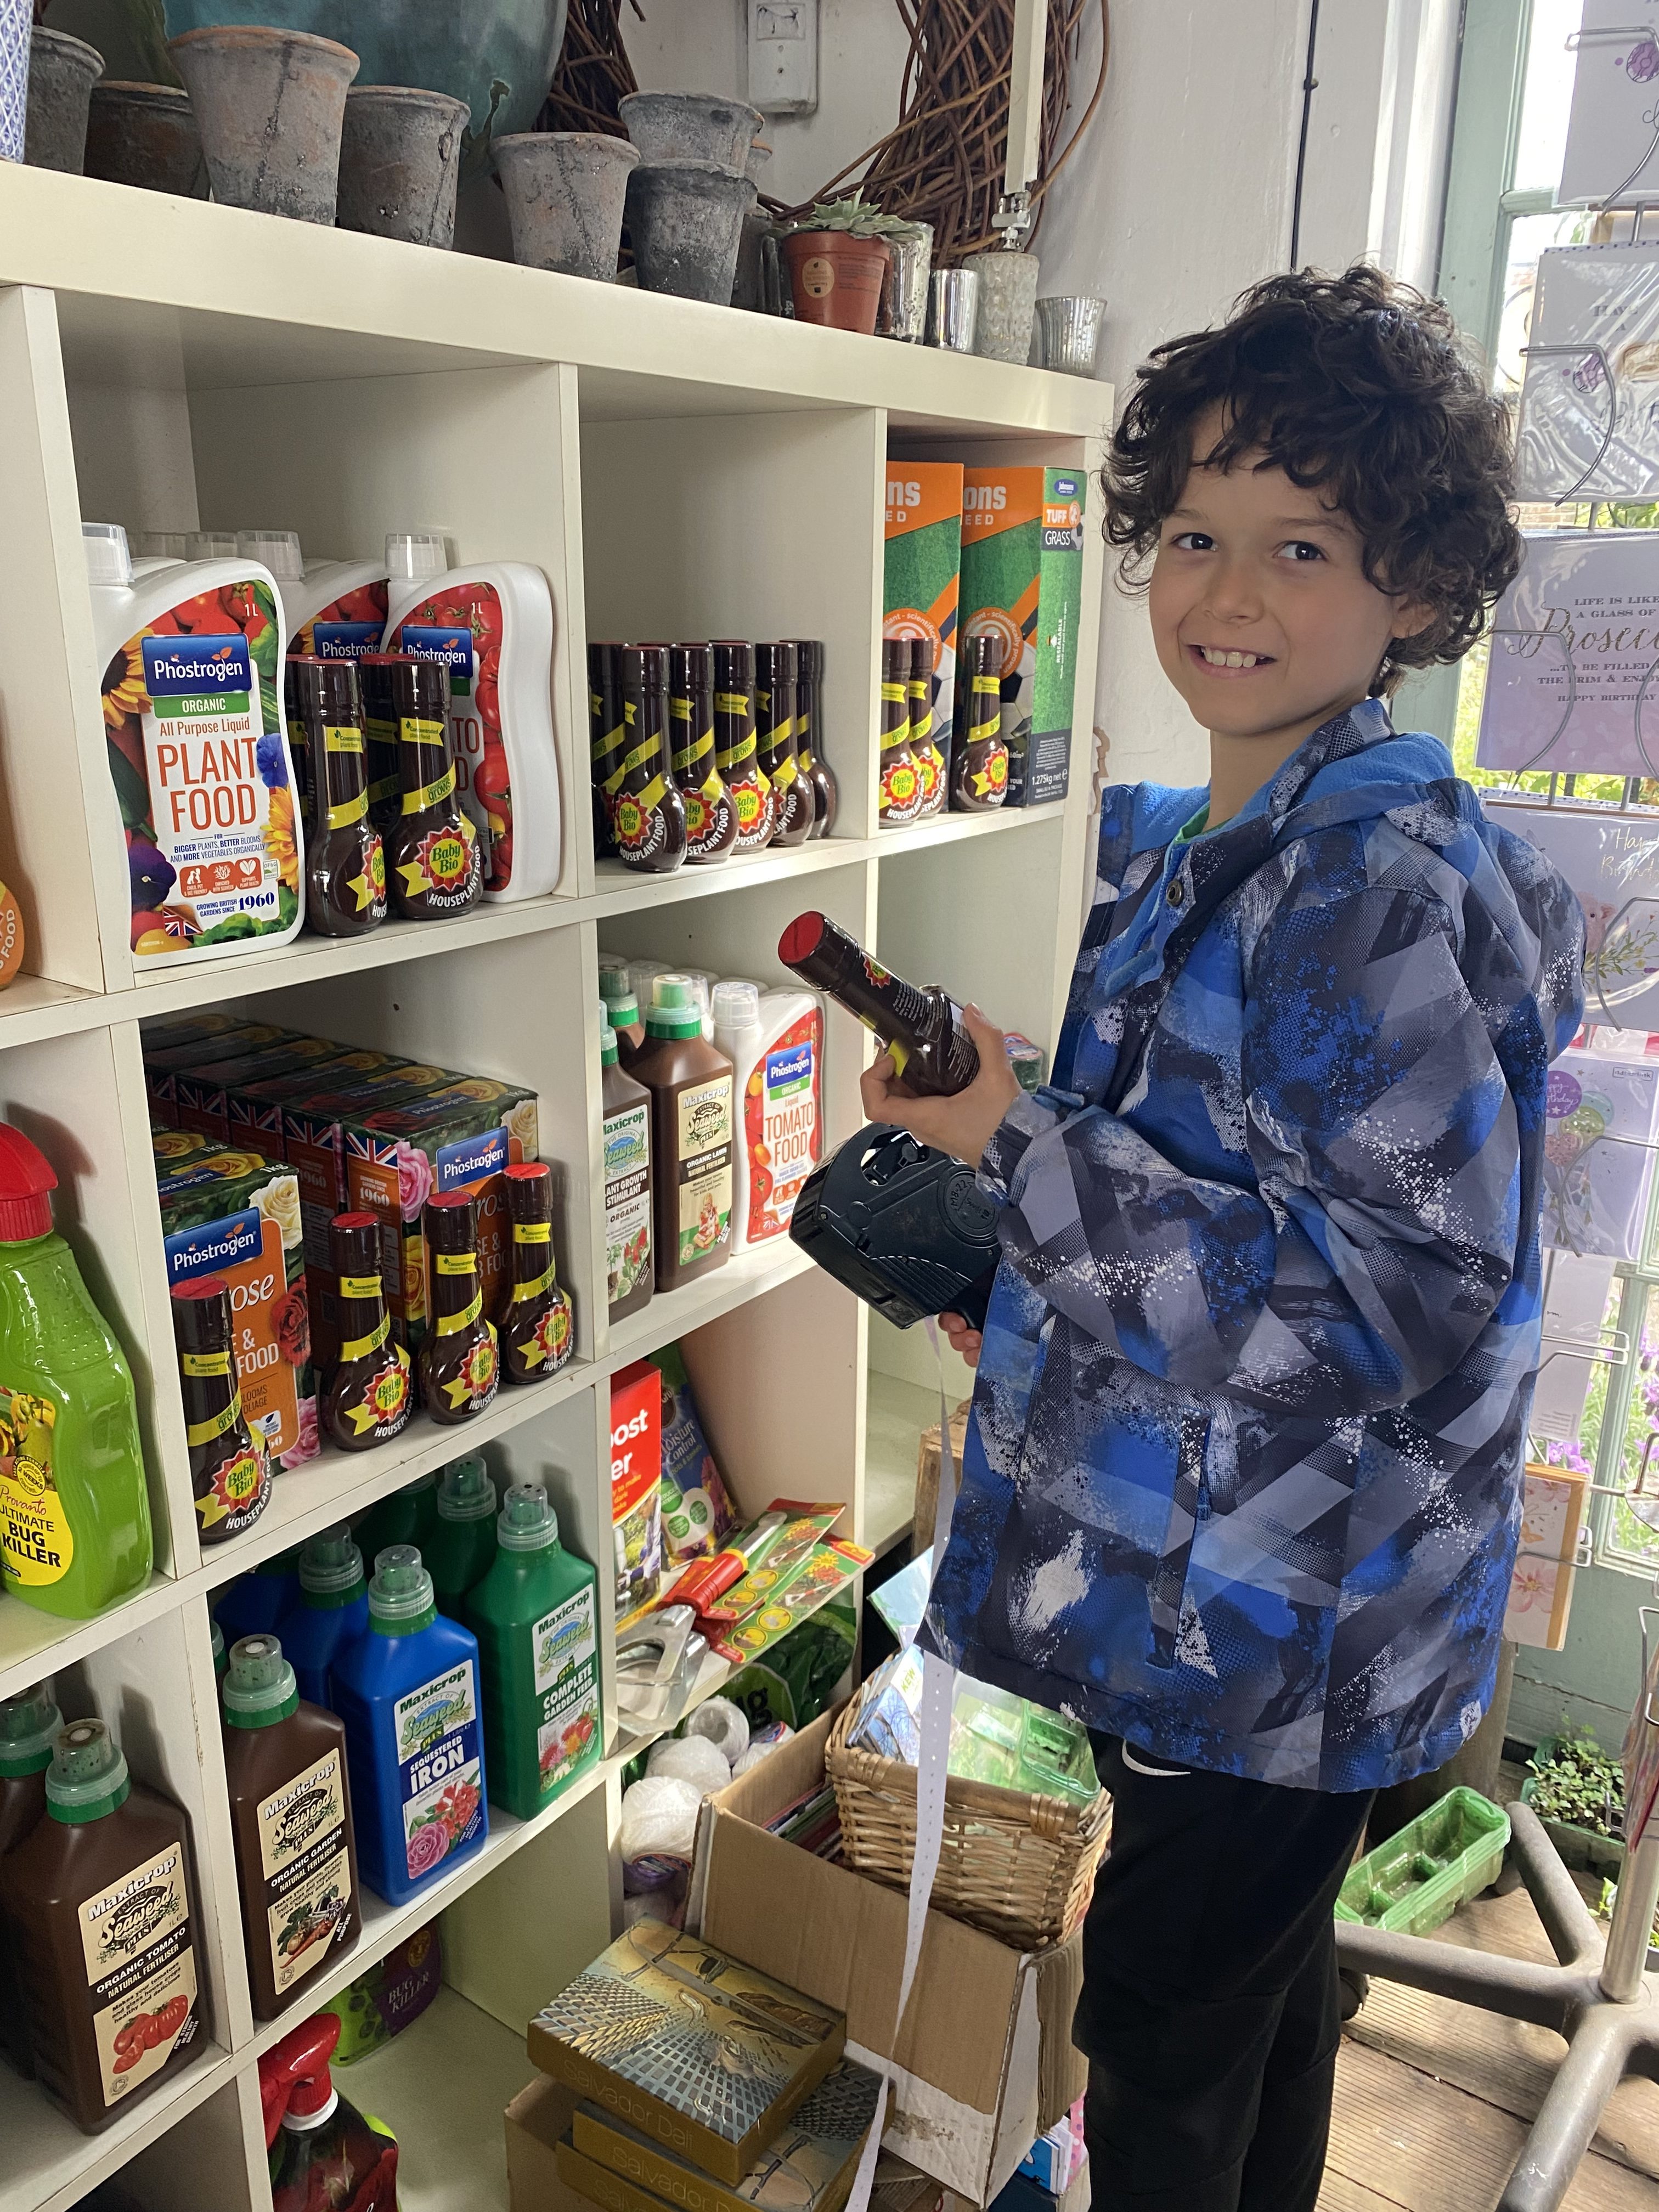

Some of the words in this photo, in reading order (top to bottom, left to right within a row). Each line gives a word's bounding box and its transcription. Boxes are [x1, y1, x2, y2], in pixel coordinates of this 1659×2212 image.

[1046, 509, 1067, 523] TUFF
[1045, 531, 1070, 546] GRASS
[1628, 596, 1659, 604] LIKE
[408, 644, 466, 667] Phostrogen
[154, 658, 242, 681] Phostrogen
[182, 698, 226, 713] ORGANIC
[160, 722, 173, 736] All
[177, 721, 218, 737] Purpose
[222, 716, 250, 734] Liquid
[157, 737, 256, 787] PLANT
[893, 772, 912, 786] Baby
[897, 783, 911, 795] Bio
[1032, 774, 1052, 785] 1.275kg
[170, 783, 256, 833] FOOD
[620, 808, 638, 822] Baby
[739, 805, 754, 817] Bio
[788, 793, 797, 819] FOOD
[887, 796, 922, 820] HOUSEPLANT
[624, 820, 636, 831] Bio
[720, 807, 729, 834] FOOD
[174, 843, 196, 853] BIGGER
[198, 840, 219, 850] PLANTS,
[220, 839, 239, 848] BETTER
[241, 835, 261, 844] BLOOMS
[619, 840, 658, 861] HOUSEPLANT
[655, 815, 664, 841] FOOD
[170, 854, 182, 863] AND
[183, 851, 200, 861] MORE
[201, 848, 233, 859] VEGETABLES
[234, 843, 265, 855] ORGANICALLY
[431, 843, 461, 863] Baby
[439, 857, 459, 874] Bio
[196, 902, 218, 911] GROWING
[219, 899, 237, 907] BRITISH
[238, 892, 274, 911] 1960
[428, 876, 479, 908] HOUSEPLANT
[1, 909, 15, 958] FOOD
[771, 1057, 809, 1079] Phostrogen
[683, 1085, 729, 1109] Maxicrop
[782, 1081, 802, 1096] ORGANIC
[785, 1095, 799, 1107] Liquid
[413, 1096, 467, 1115] Phostrogen
[697, 1103, 714, 1114] EXTRACT
[686, 1104, 726, 1135] Seaweed
[765, 1102, 813, 1142] TOMATO
[700, 1131, 713, 1143] PLUS
[774, 1131, 807, 1167] FOOD
[259, 1164, 289, 1173] 1kg
[444, 1148, 504, 1179] Phostrogen
[687, 1153, 712, 1169] ORGANIC
[713, 1147, 727, 1159] LAWN
[688, 1165, 706, 1177] NATURAL
[706, 1156, 726, 1173] FERTILISER
[620, 1170, 647, 1189] GROWTH
[359, 1187, 390, 1207] 1960
[607, 1183, 641, 1207] STIMULANT
[610, 1203, 640, 1223] ORGANIC
[174, 1233, 254, 1271] Phostrogen
[546, 1315, 566, 1336] Baby
[551, 1328, 565, 1344] Bio
[242, 1328, 255, 1351] &
[236, 1342, 279, 1378] FOOD
[478, 1364, 490, 1381] Bio
[378, 1376, 401, 1398] Baby
[383, 1391, 400, 1408] Bio
[666, 1436, 696, 1465] Control
[23, 1470, 43, 1489] WEEKS
[228, 1461, 255, 1488] Baby
[234, 1476, 253, 1498] Bio
[0, 1485, 47, 1515] Provanto
[226, 1481, 270, 1530] HOUSEPLANT
[9, 1521, 46, 1547] BUG
[2, 1532, 61, 1568] KILLER
[539, 1592, 589, 1635] Maxicrop
[539, 1610, 590, 1663] Seaweed
[400, 1667, 466, 1715] Maxicrop
[544, 1662, 592, 1709] COMPLETE
[901, 1667, 915, 1693] KEW
[417, 1694, 443, 1714] EXTRACT
[544, 1691, 575, 1720] GARDEN
[577, 1677, 592, 1695] FEED
[400, 1689, 466, 1746] Seaweed
[410, 1735, 462, 1773] SEQUESTERED
[410, 1743, 465, 1795] IRON
[264, 1761, 335, 1820] Maxicrop
[273, 1785, 332, 1845] Seaweed
[288, 1794, 313, 1814] EXTRACT
[295, 1826, 313, 1848] PLUS
[271, 1853, 309, 1887] ORGANIC
[311, 1828, 342, 1857] GARDEN
[279, 1868, 306, 1892] NATURAL
[307, 1843, 336, 1872] FERTILISER
[88, 1856, 176, 1921] Maxicrop
[117, 1892, 149, 1915] EXTRACT
[151, 1887, 161, 1895] OF
[274, 1895, 292, 1910] Makes
[294, 1884, 306, 1898] your
[276, 1904, 287, 1915] fruit
[289, 1891, 304, 1906] crops
[306, 1882, 315, 1893] and
[280, 1906, 294, 1920] grow
[295, 1891, 314, 1908] healthy
[315, 1881, 324, 1892] and
[98, 1881, 173, 1948] Seaweed
[337, 1913, 352, 1942] PURPOSE
[127, 1927, 150, 1949] PLUS
[97, 1959, 144, 1994] ORGANIC
[146, 1927, 185, 1960] TOMATO
[108, 1972, 142, 1998] NATURAL
[143, 1944, 179, 1977] FERTILISER
[112, 1995, 134, 2011] Makes
[136, 1982, 149, 1997] your
[151, 1961, 179, 1984] tomatoes
[112, 2007, 125, 2019] and
[126, 1995, 143, 2012] glass
[144, 1979, 163, 1996] house
[164, 1967, 180, 1984] crops
[114, 2004, 138, 2024] healthy
[140, 1994, 152, 2006] and
[153, 1974, 180, 1996] delicious
[388, 1976, 413, 2004] BUG
[393, 1972, 428, 2013] KILLER
[564, 2060, 652, 2124] Salvador
[613, 2147, 710, 2211] Salvador
